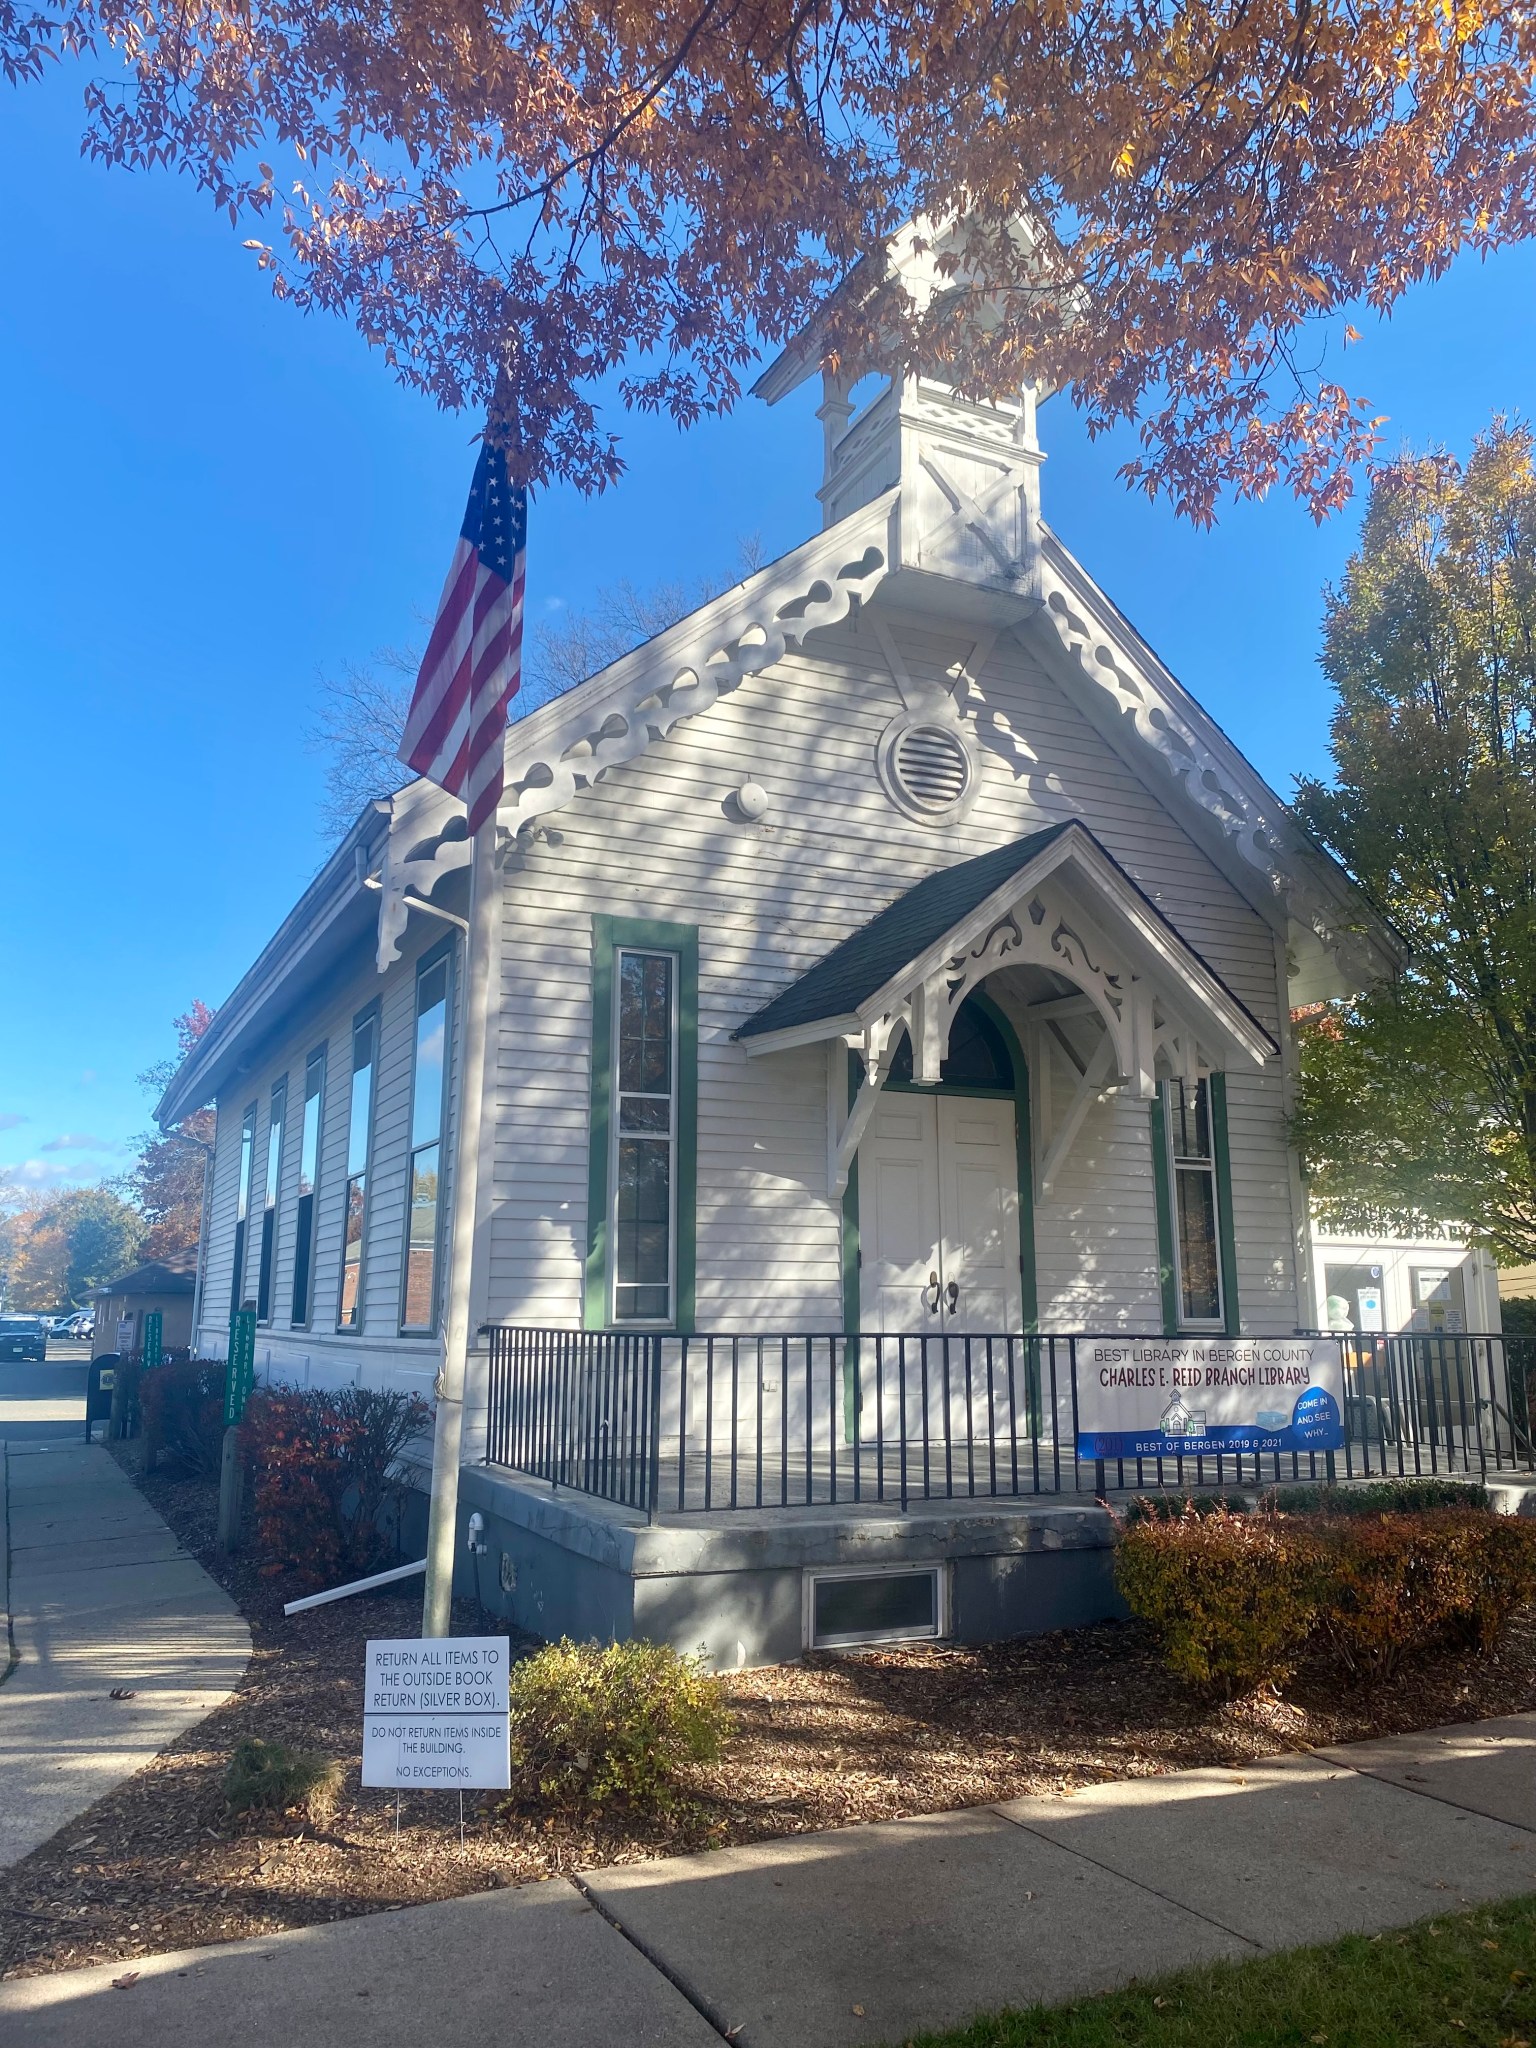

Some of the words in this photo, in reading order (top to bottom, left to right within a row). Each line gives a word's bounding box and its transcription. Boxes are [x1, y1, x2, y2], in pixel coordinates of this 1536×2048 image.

[1094, 1349, 1130, 1362] BEST
[1132, 1349, 1189, 1362] LIBRARY
[1192, 1349, 1205, 1362] IN
[1209, 1349, 1260, 1362] BERGEN
[1263, 1349, 1315, 1362] COUNTY
[229, 1315, 240, 1419] RESERVED
[1099, 1367, 1156, 1387] CHARLES
[1159, 1367, 1169, 1387] E.
[1172, 1367, 1202, 1387] REID
[1205, 1366, 1256, 1387] BRANCH
[1258, 1366, 1311, 1386] LIBRARY
[1297, 1398, 1319, 1410] COME
[1319, 1397, 1328, 1406] IN
[1296, 1414, 1314, 1425] AND
[1314, 1411, 1331, 1422] SEE
[1135, 1442, 1163, 1452] BEST
[1166, 1441, 1180, 1451] OF
[1184, 1440, 1225, 1450] BERGEN
[1229, 1439, 1250, 1449] 2019
[1252, 1439, 1259, 1448] &
[1261, 1438, 1282, 1447] 2021
[375, 1652, 418, 1666] RETURN
[421, 1652, 442, 1665] ALL
[445, 1650, 478, 1665] ITEMS
[482, 1649, 499, 1664] TO
[380, 1672, 400, 1686] THE
[402, 1672, 452, 1686] OUTSIDE
[455, 1671, 493, 1685] BOOK
[373, 1693, 416, 1707] RETURN
[420, 1692, 460, 1710] (SILVER
[464, 1691, 500, 1709] BOX).
[371, 1727, 386, 1738] DO
[388, 1727, 407, 1738] NOT
[408, 1727, 442, 1738] RETURN
[443, 1727, 469, 1738] ITEMS
[471, 1726, 501, 1738] INSIDE
[402, 1743, 418, 1754] THE
[420, 1742, 466, 1754] BUILDING.
[396, 1767, 411, 1777] NO
[413, 1766, 472, 1778] EXCEPTIONS.
